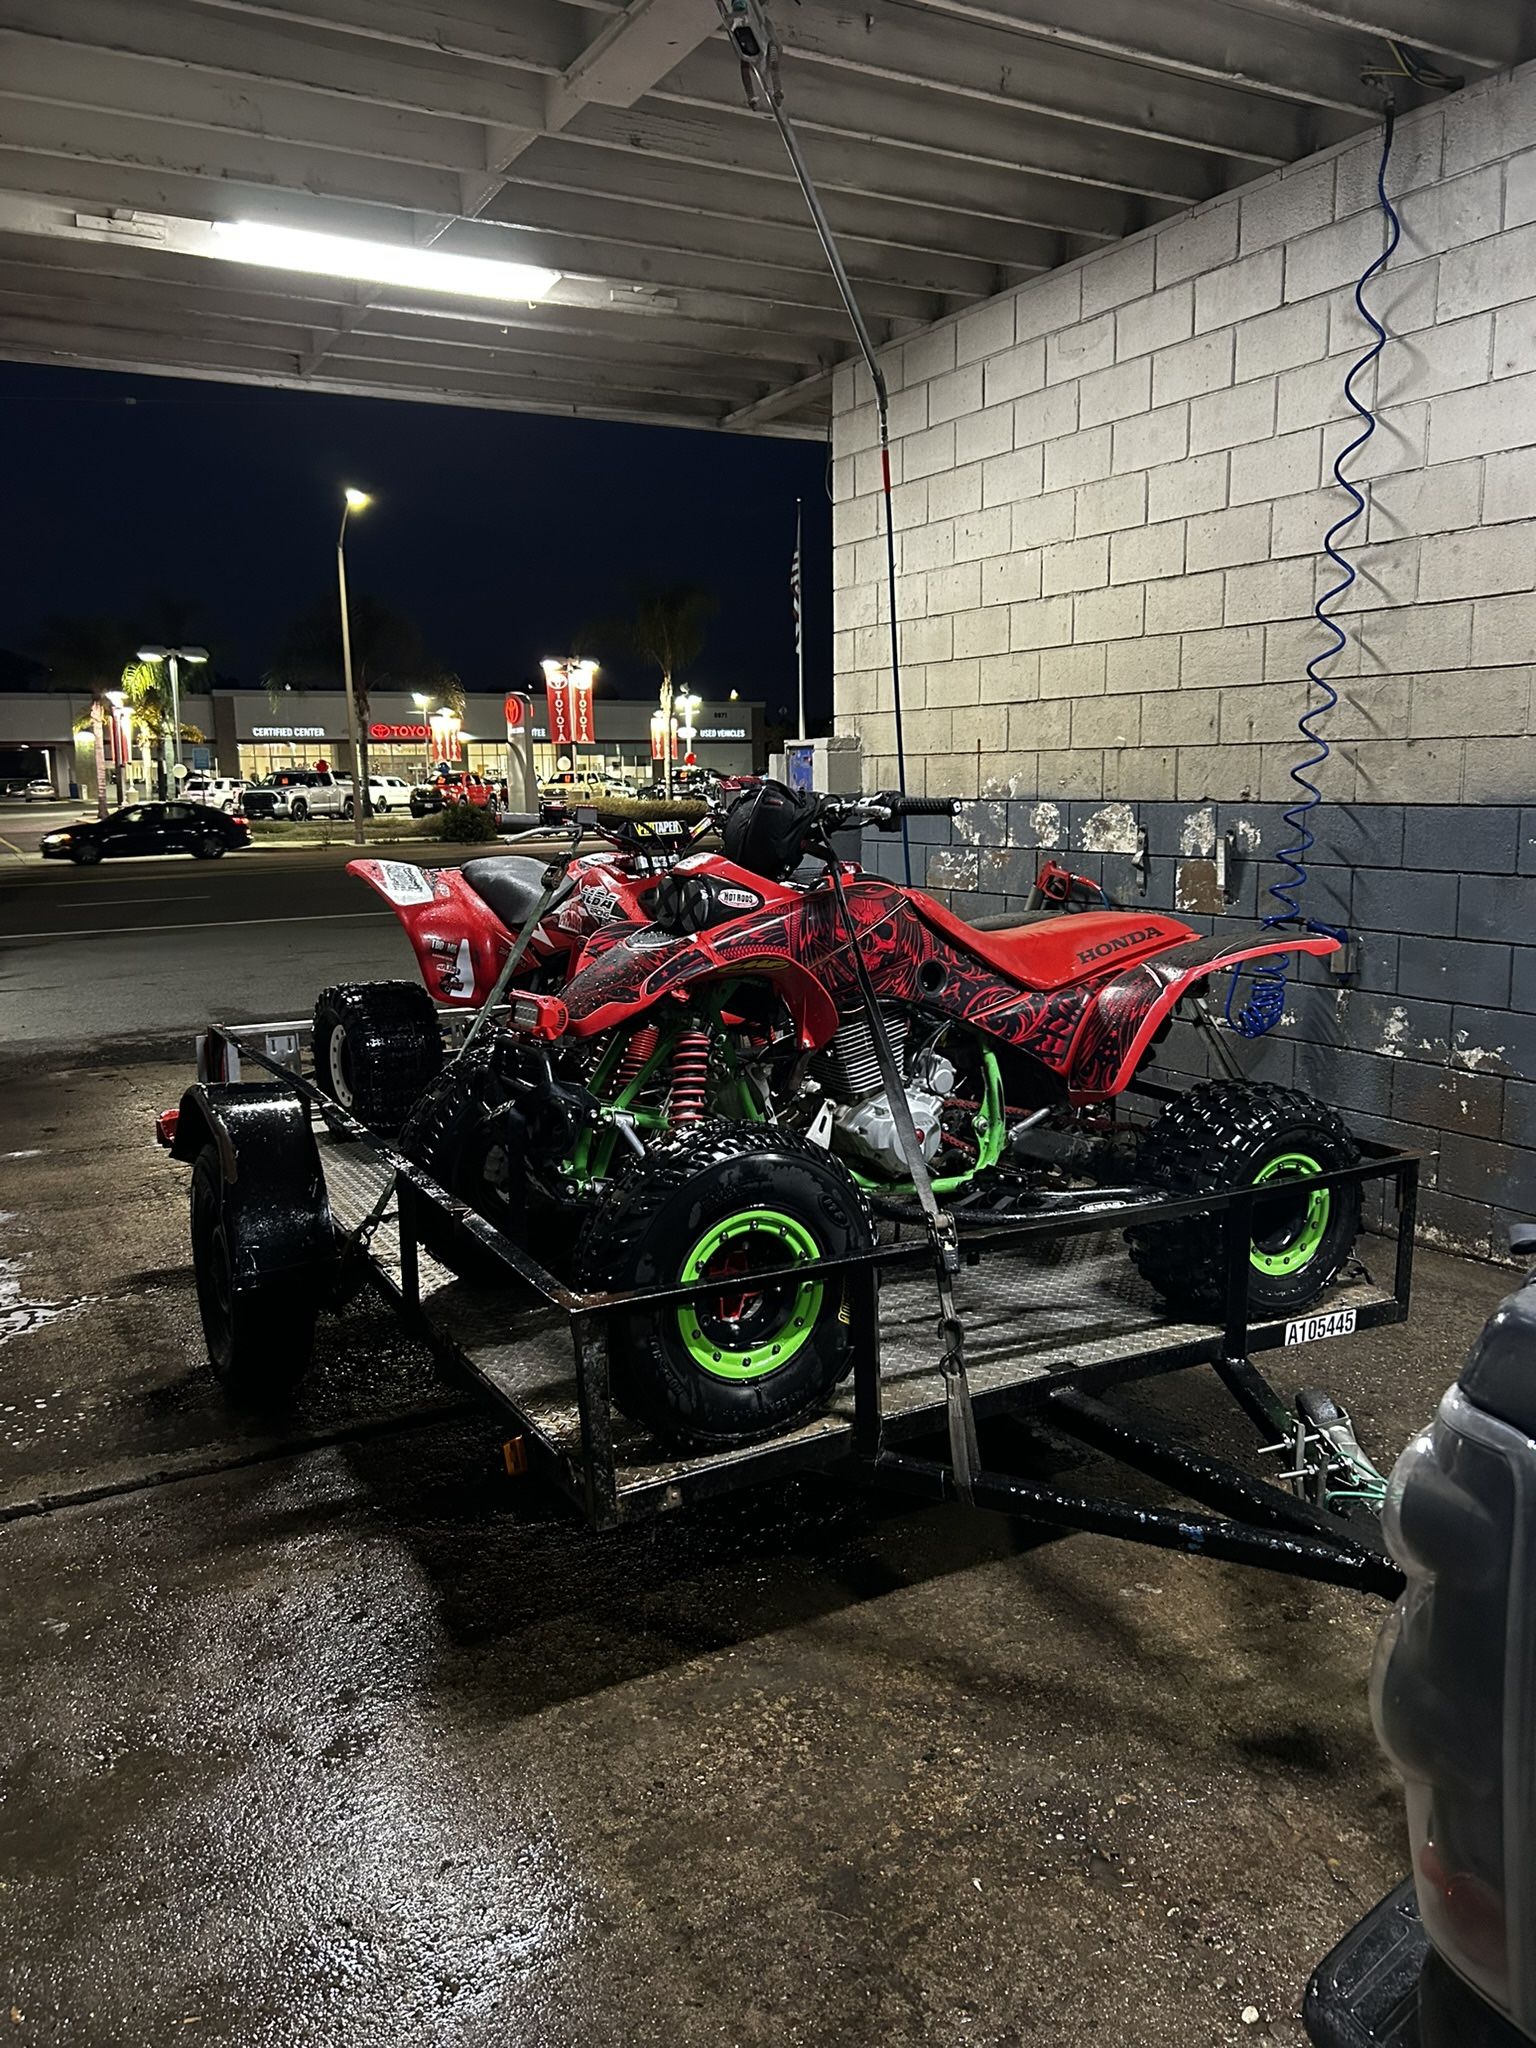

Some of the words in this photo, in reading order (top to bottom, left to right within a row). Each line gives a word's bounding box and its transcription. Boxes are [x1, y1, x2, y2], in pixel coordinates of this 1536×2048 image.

[555, 690, 566, 742] TOYOTA
[579, 690, 589, 742] TOYOTA
[252, 727, 292, 737] CERTIFIED
[293, 727, 325, 737] CENTER
[391, 726, 432, 737] TOYOT
[700, 729, 716, 738] USED
[717, 729, 746, 738] VEHICLES
[724, 891, 736, 902] HOT
[737, 893, 753, 903] RODS
[1076, 926, 1165, 965] HONDA
[1287, 1311, 1354, 1345] A105445
